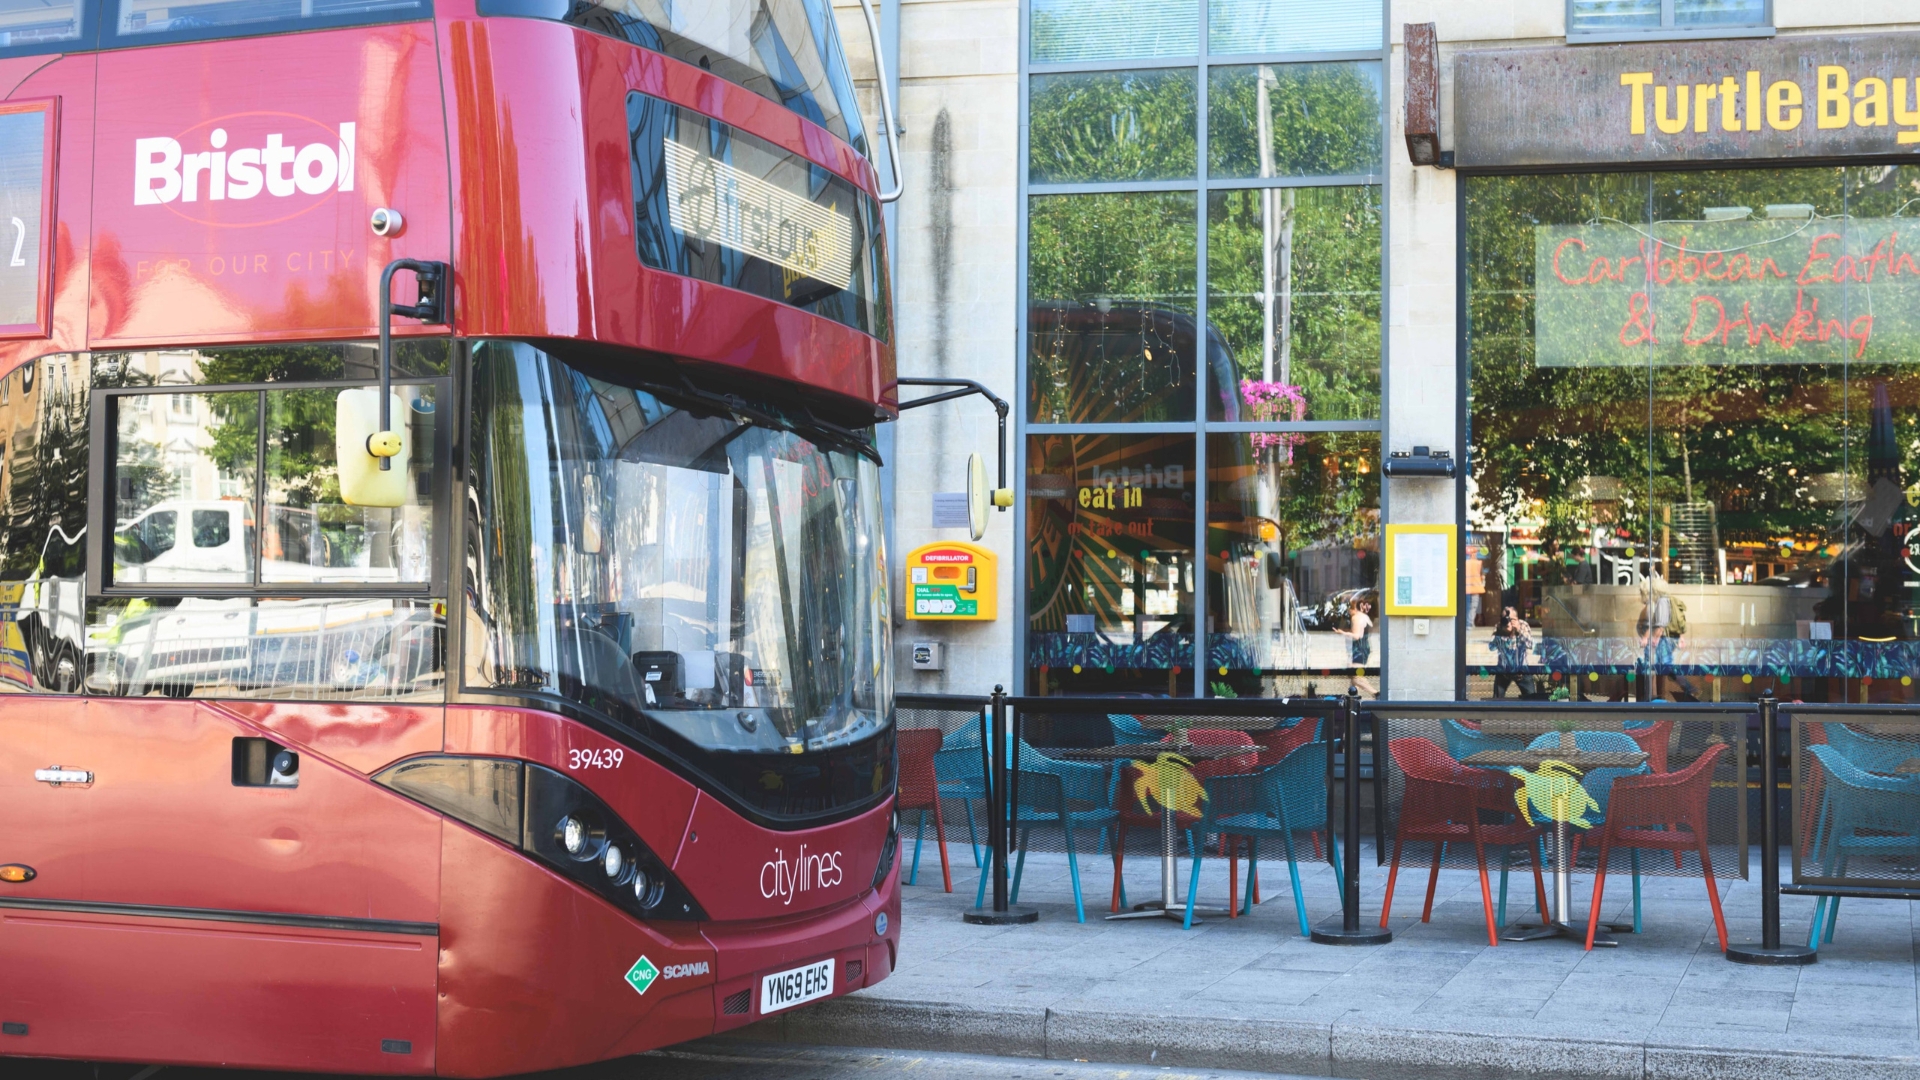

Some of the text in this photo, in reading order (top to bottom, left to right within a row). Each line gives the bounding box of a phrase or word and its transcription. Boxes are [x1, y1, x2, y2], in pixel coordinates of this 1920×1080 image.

[1620, 65, 1920, 144] Turtle Bay
[133, 121, 356, 206] Bristol
[10, 216, 26, 267] 2
[1553, 235, 1786, 286] Caribbean
[136, 249, 355, 280] FOR OUR CITY
[1619, 288, 1873, 359] & Drinking
[1078, 480, 1143, 511] eat in
[1088, 517, 1123, 538] take
[1128, 517, 1155, 538] out
[924, 554, 970, 562] DEFIBRILLATOR
[568, 748, 624, 770] 39439
[760, 843, 843, 906] citylines
[632, 961, 710, 982] CNG SCANIA
[768, 964, 829, 1006] YN69 EHS
